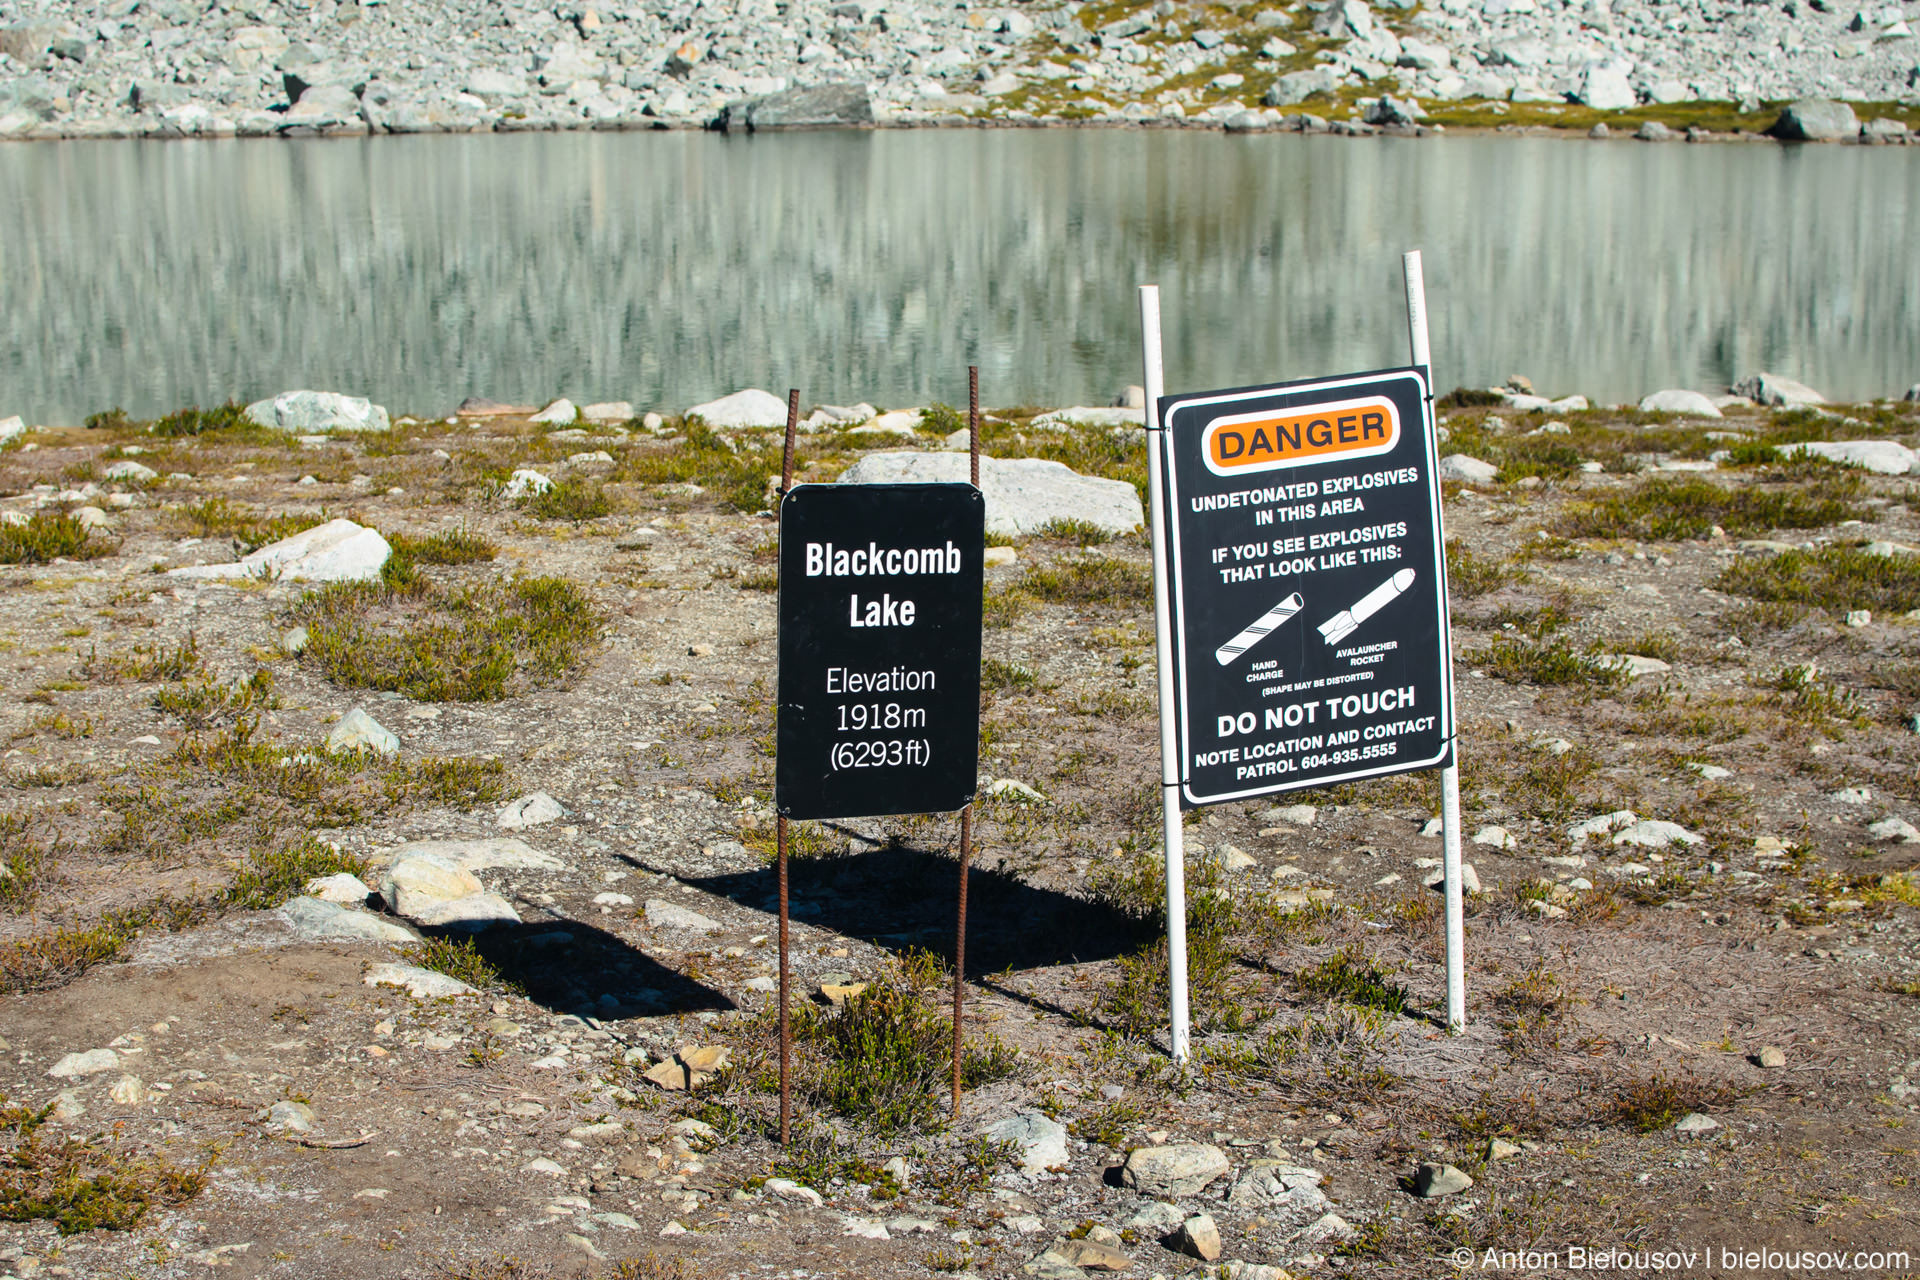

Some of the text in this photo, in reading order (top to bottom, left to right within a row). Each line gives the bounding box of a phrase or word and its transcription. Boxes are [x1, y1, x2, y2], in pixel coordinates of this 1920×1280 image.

[1219, 413, 1384, 459] DANGER
[1192, 467, 1418, 512] UNDETONATED EXPLOSIVES
[1256, 497, 1364, 525] IN THIS AREA
[807, 541, 960, 576] Blackcomb
[1213, 522, 1407, 563] IF YOU SEE EXPLOSIVES
[1220, 545, 1401, 583] THAT LOOK LIKE THIS:
[851, 594, 915, 627] Lake
[1252, 660, 1277, 671] HAND
[1336, 641, 1397, 658] AVALAUNCHER
[1351, 654, 1384, 665] ROCKET
[827, 666, 934, 693] Elevation
[1246, 670, 1283, 682] CHARGE
[1262, 671, 1374, 697] (SHAPE MAY BE DISTORTED)
[838, 703, 925, 730] 1918m
[1218, 686, 1414, 737] DO NOT TOUCH
[1196, 716, 1435, 767] NOTE LOCATION AND CONTACT
[1237, 742, 1396, 780] PATROL 604-935.5555
